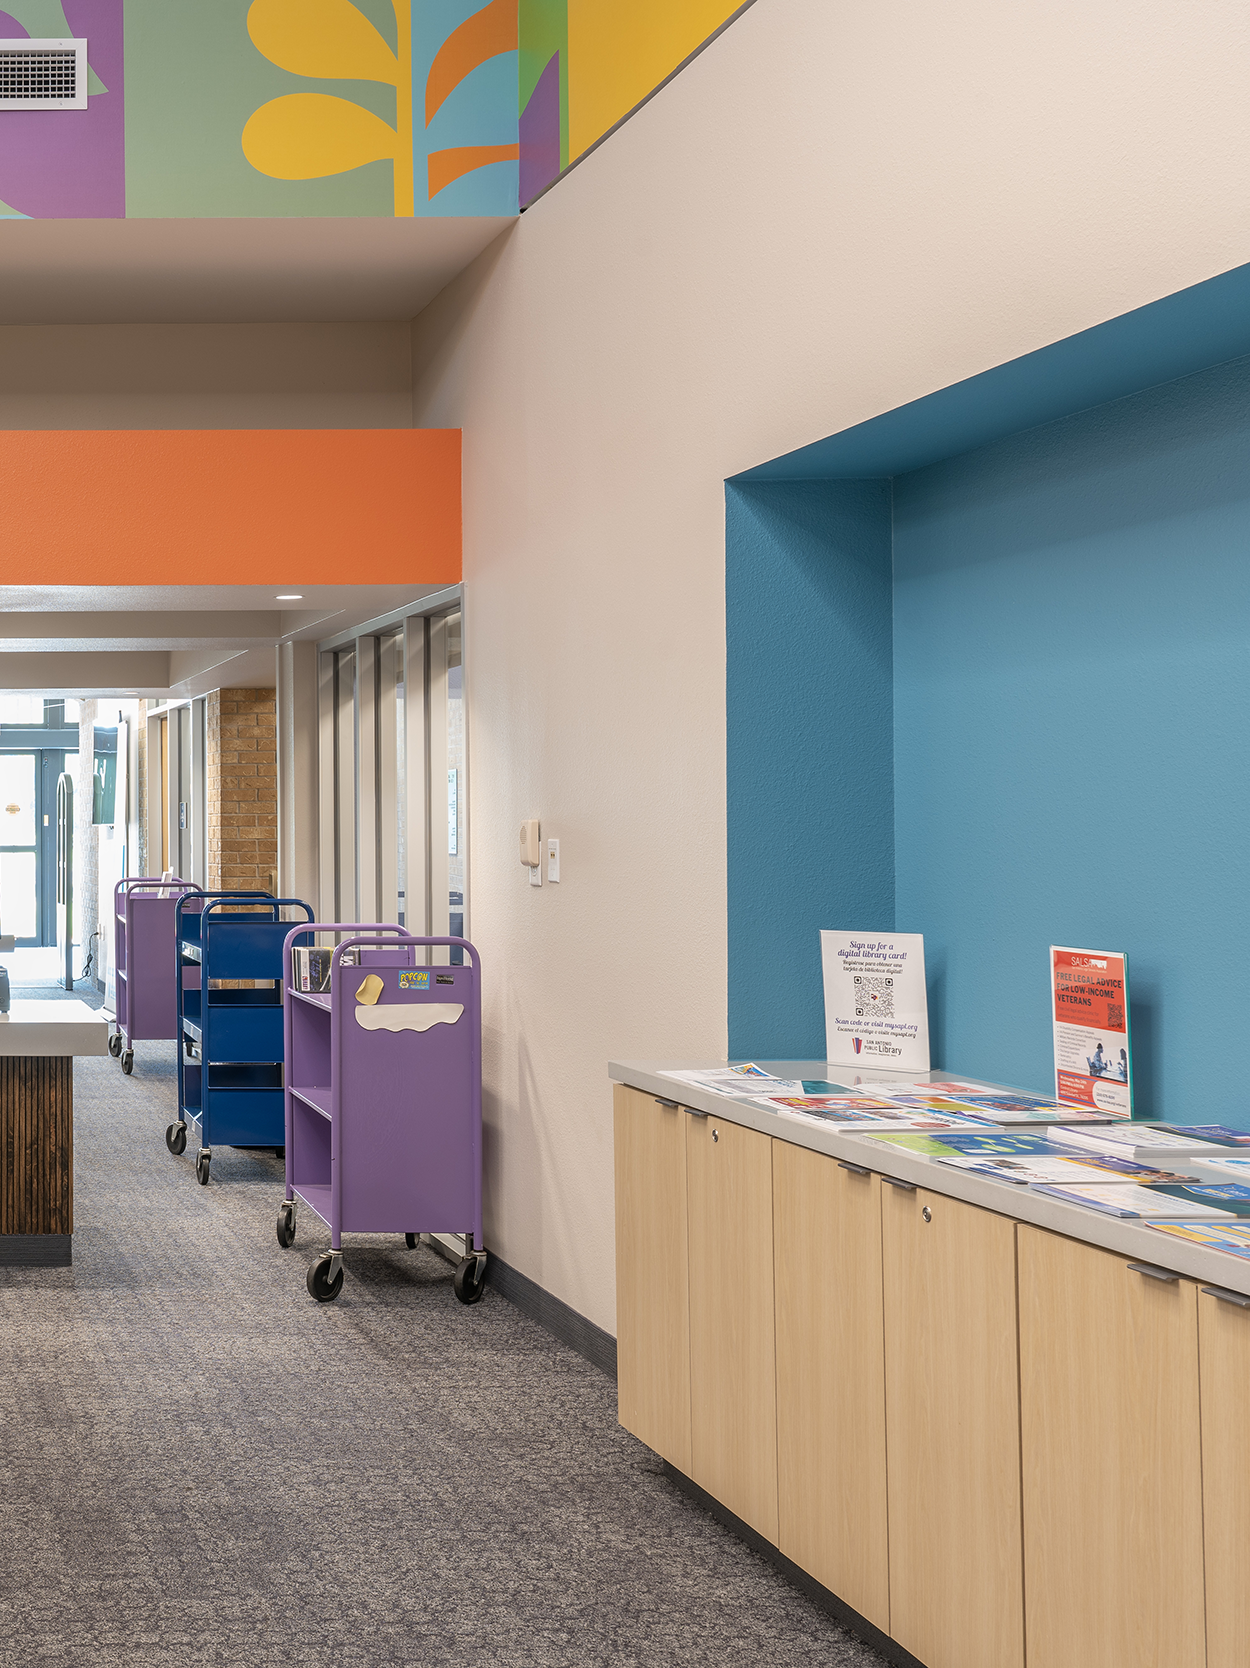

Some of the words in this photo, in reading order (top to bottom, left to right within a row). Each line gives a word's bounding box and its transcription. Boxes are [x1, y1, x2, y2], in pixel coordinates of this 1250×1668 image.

[850, 941, 865, 950] Sign
[876, 942, 887, 951] for
[838, 950, 860, 958] digital
[862, 951, 887, 960] library
[1071, 956, 1093, 968] SALSA
[401, 972, 428, 982] POPCON
[1056, 972, 1072, 981] FREE
[1073, 974, 1094, 984] LEGAL
[1096, 977, 1122, 988] ADVICE
[1057, 983, 1069, 992] FOR
[1071, 986, 1114, 999] LOW-INCOME
[1057, 994, 1092, 1006] VETERANS
[885, 1022, 918, 1032] mysapl.org
[878, 1045, 902, 1055] Library
